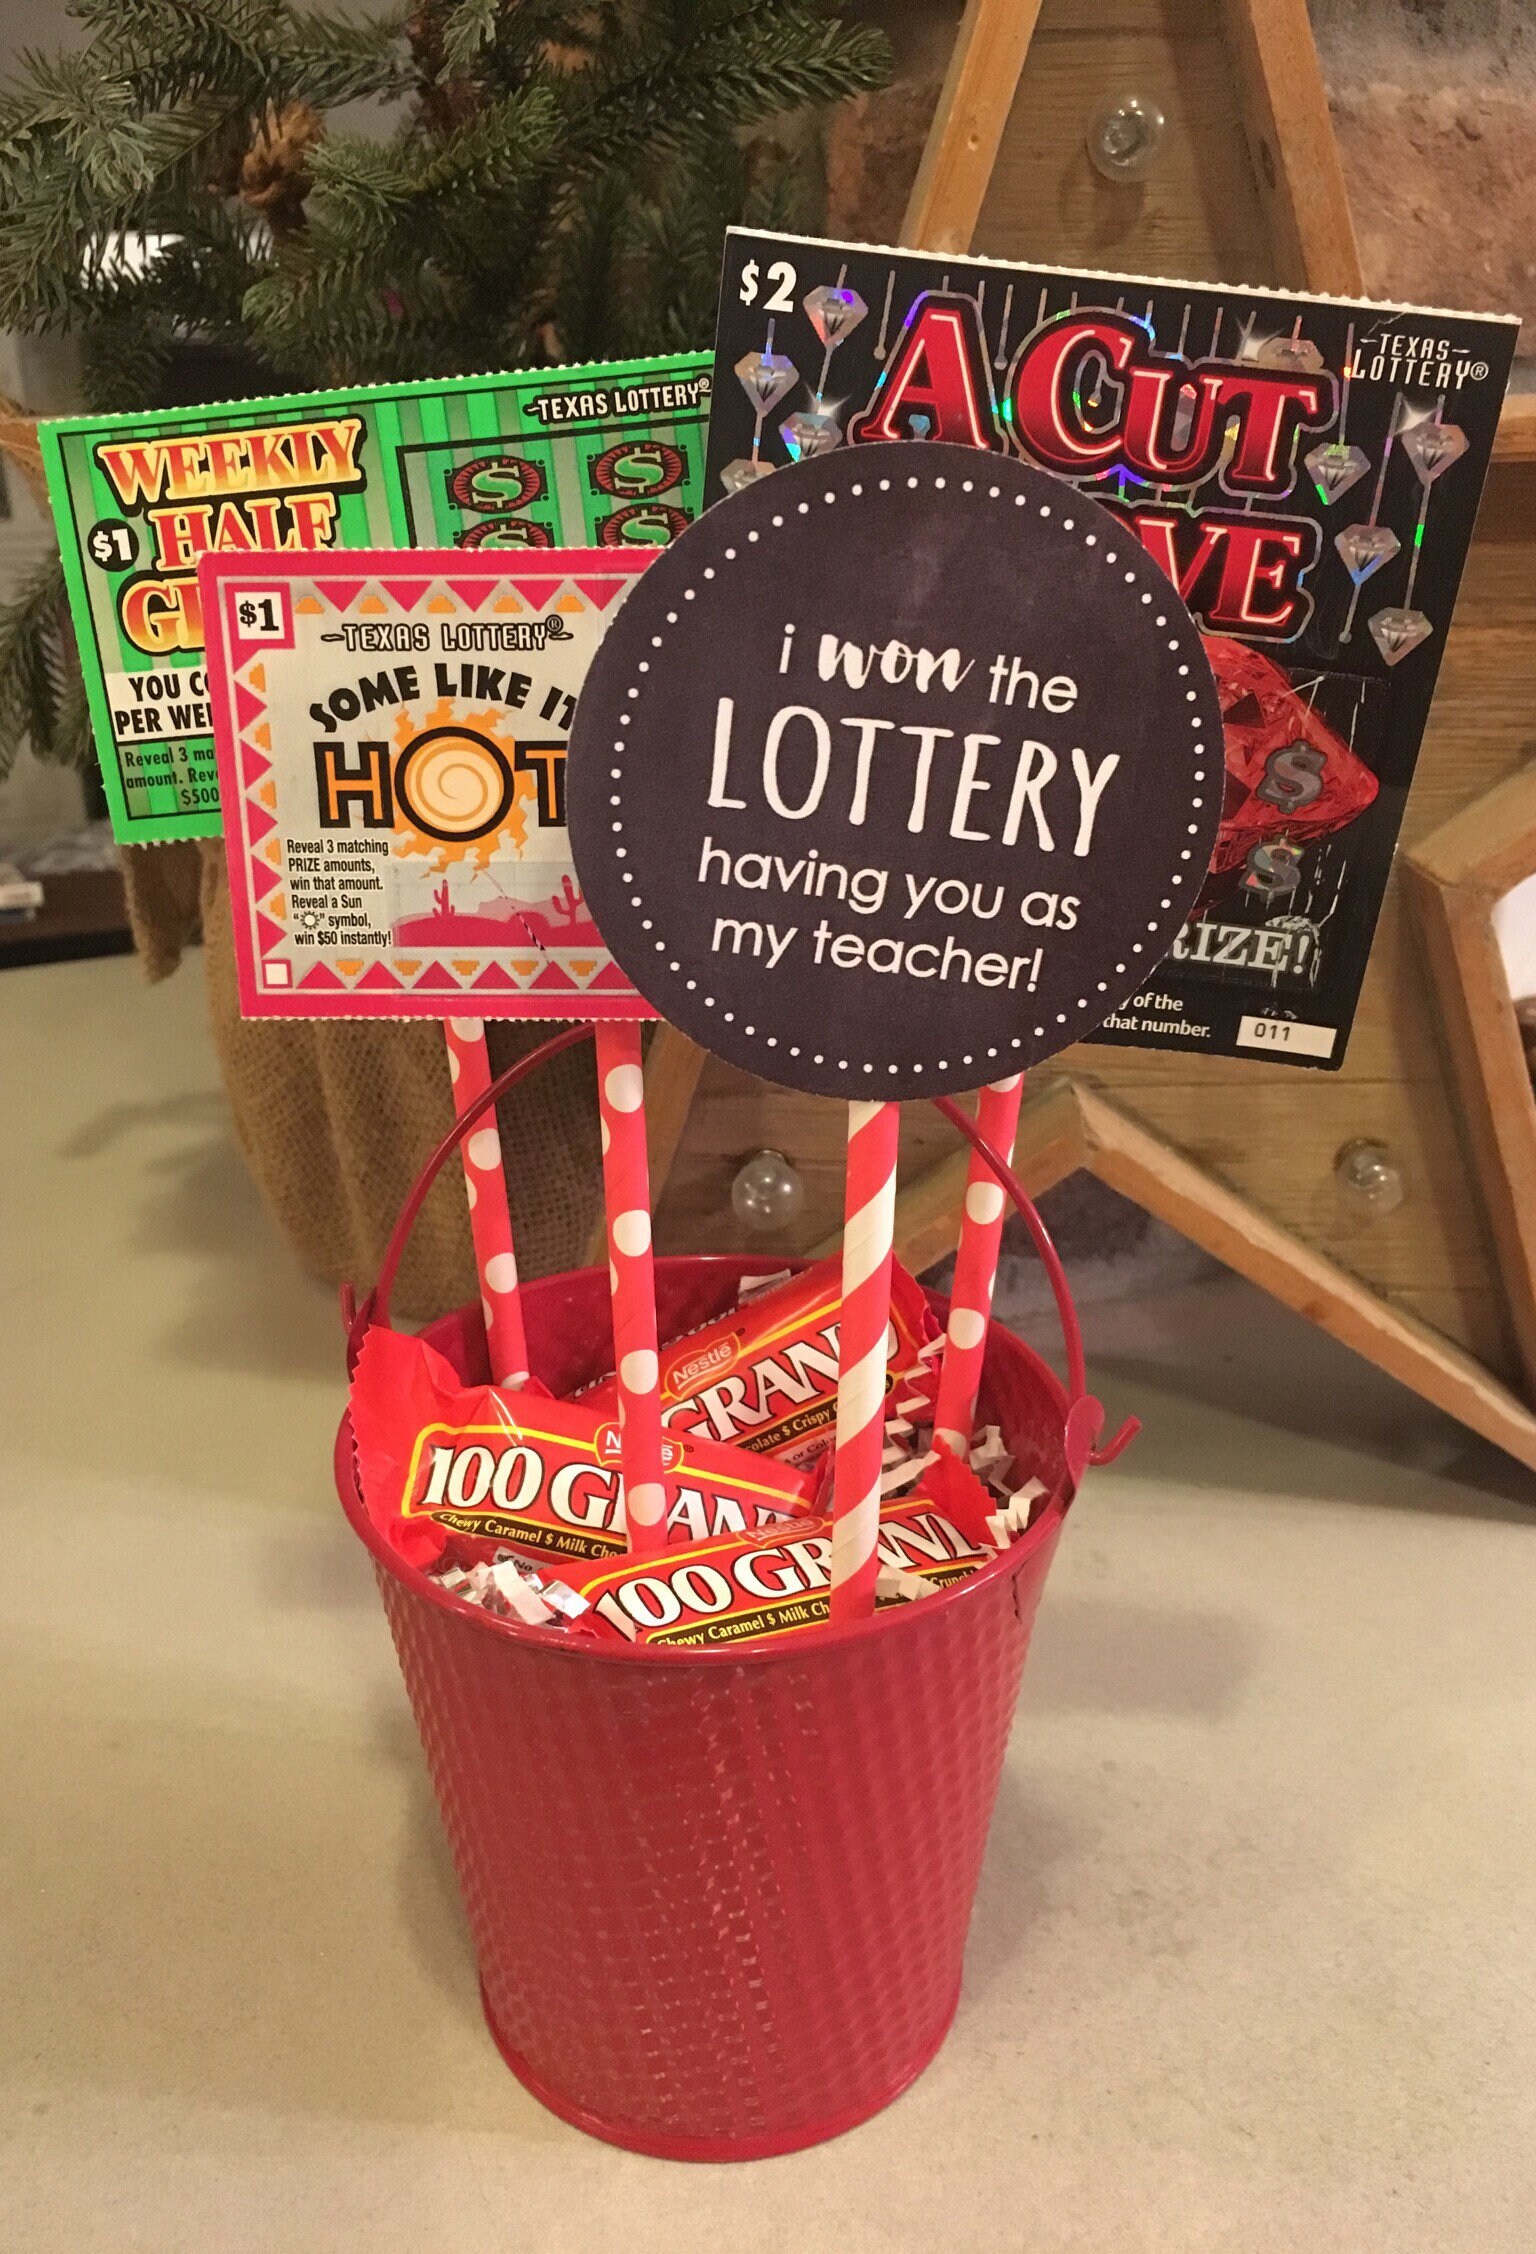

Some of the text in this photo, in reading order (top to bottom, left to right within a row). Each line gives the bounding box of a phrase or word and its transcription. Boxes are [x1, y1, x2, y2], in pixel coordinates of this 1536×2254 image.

[739, 259, 797, 313] $2
[1380, 333, 1450, 360] TEXAS
[861, 307, 990, 450] A
[537, 393, 608, 421] TEXAS
[98, 418, 362, 505] WEEKLY
[92, 528, 133, 562] $1
[148, 492, 337, 572] HALF
[238, 599, 279, 632] $1
[343, 623, 430, 652] TEXAS
[778, 623, 1079, 714] i won the
[128, 671, 209, 702] YOU C
[309, 665, 420, 733] SOME
[434, 663, 532, 709] LIKE
[114, 708, 163, 735] PER
[125, 746, 174, 767] Reveal
[178, 747, 188, 762] 3
[126, 768, 218, 788] amount. Rev
[313, 725, 568, 843] HOT
[707, 696, 1121, 857] LOTTERY
[180, 787, 219, 806] $500
[287, 839, 389, 857] Reveal 3 matching
[288, 857, 375, 874] PRIZE amounts,
[290, 876, 384, 891] win that amount.
[698, 836, 1081, 930] having you as
[291, 894, 363, 909] Reveal a Sun
[328, 912, 372, 930] symbol,
[294, 930, 392, 948] win $50 instantly!
[711, 917, 1044, 993] my teacher!
[1133, 992, 1155, 1008] of
[1154, 994, 1184, 1011] the
[1141, 1019, 1211, 1038] number.
[1254, 1022, 1290, 1041] 011
[661, 1321, 899, 1442] GRAN
[792, 1408, 830, 1433] Crispy
[419, 1444, 544, 1511] 100
[439, 1512, 481, 1532] Chewy
[484, 1518, 541, 1544] Caramel
[556, 1536, 587, 1554] Milk
[513, 1560, 533, 1572] No
[592, 1563, 735, 1643] 100
[708, 1613, 765, 1639] Caramel
[779, 1606, 810, 1625] Milk
